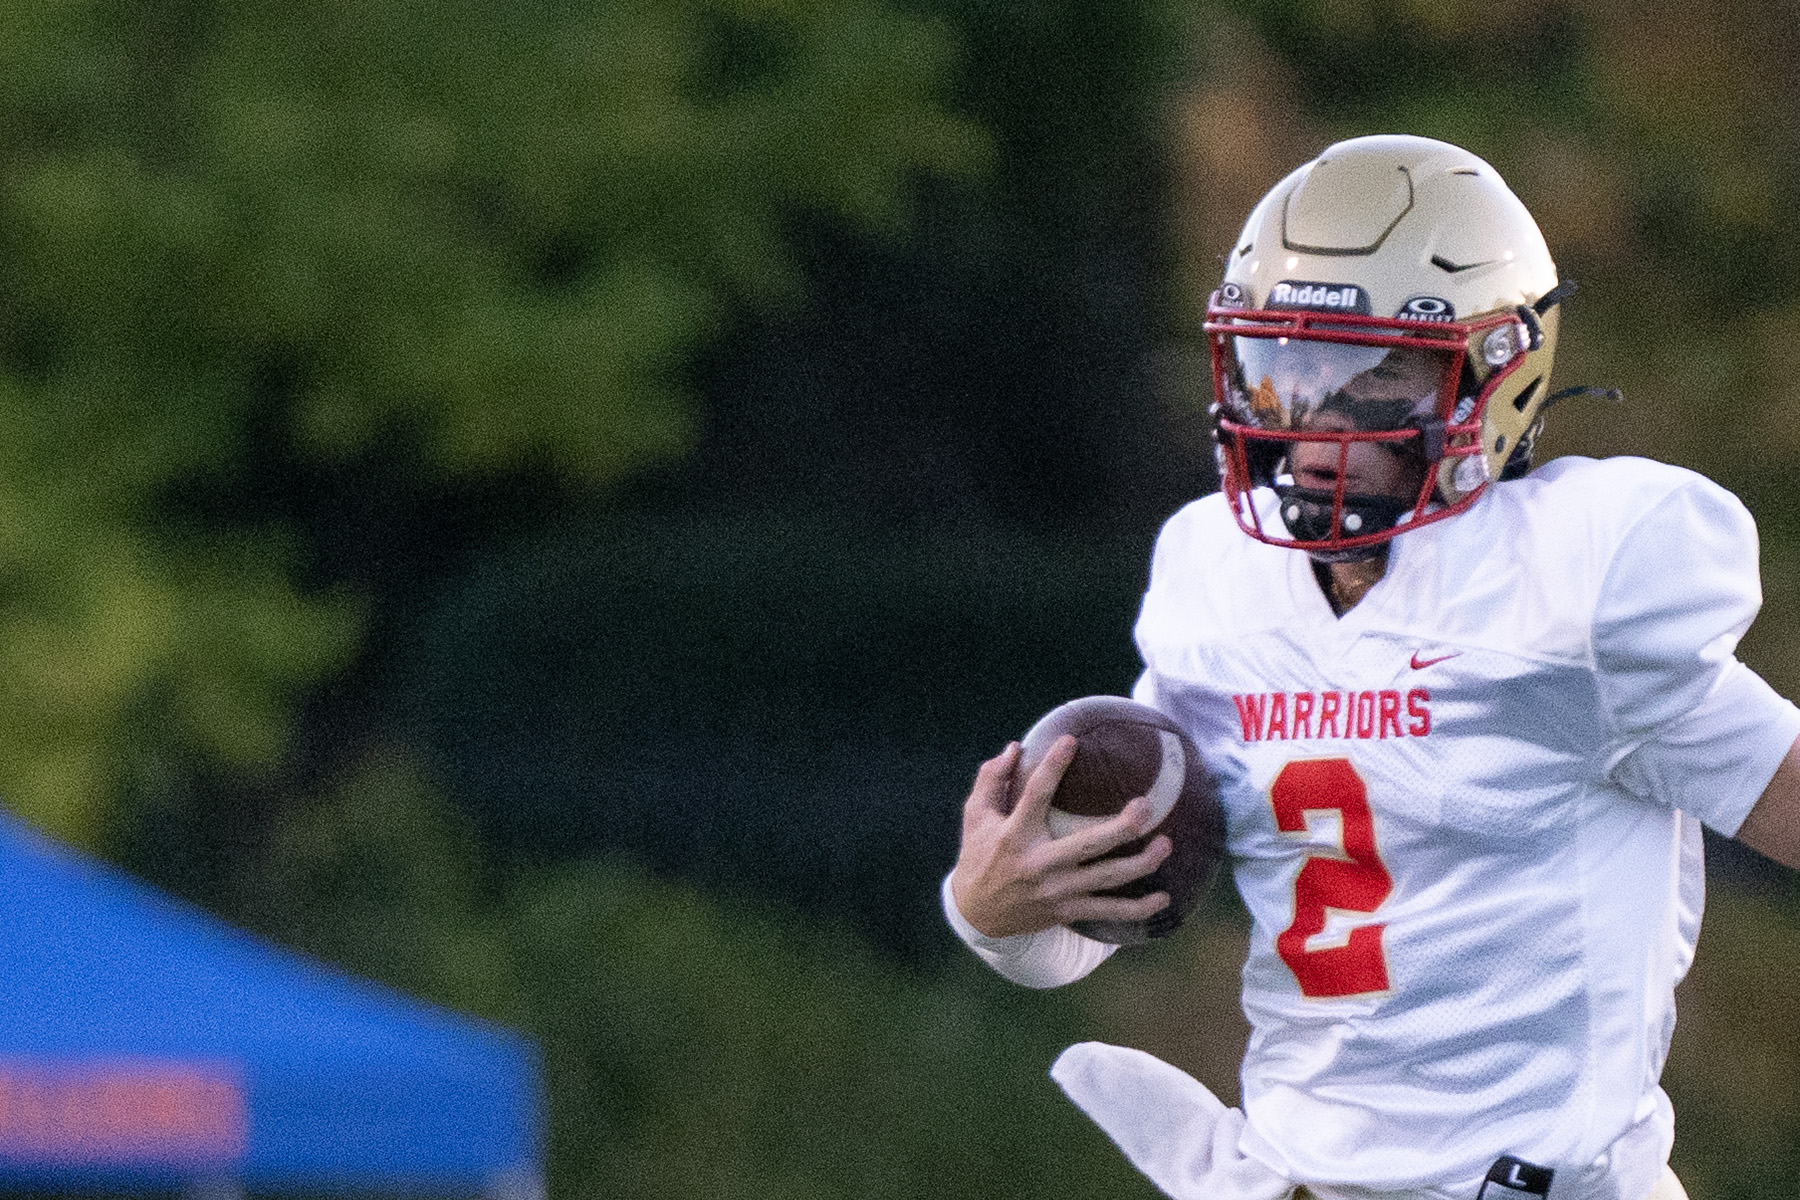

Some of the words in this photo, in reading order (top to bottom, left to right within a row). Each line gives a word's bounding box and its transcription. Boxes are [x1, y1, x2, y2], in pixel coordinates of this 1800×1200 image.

[1273, 283, 1358, 307] Riddell
[1232, 689, 1431, 742] WARRIORS
[1268, 757, 1395, 1000] 2
[1508, 1163, 1528, 1188] L
